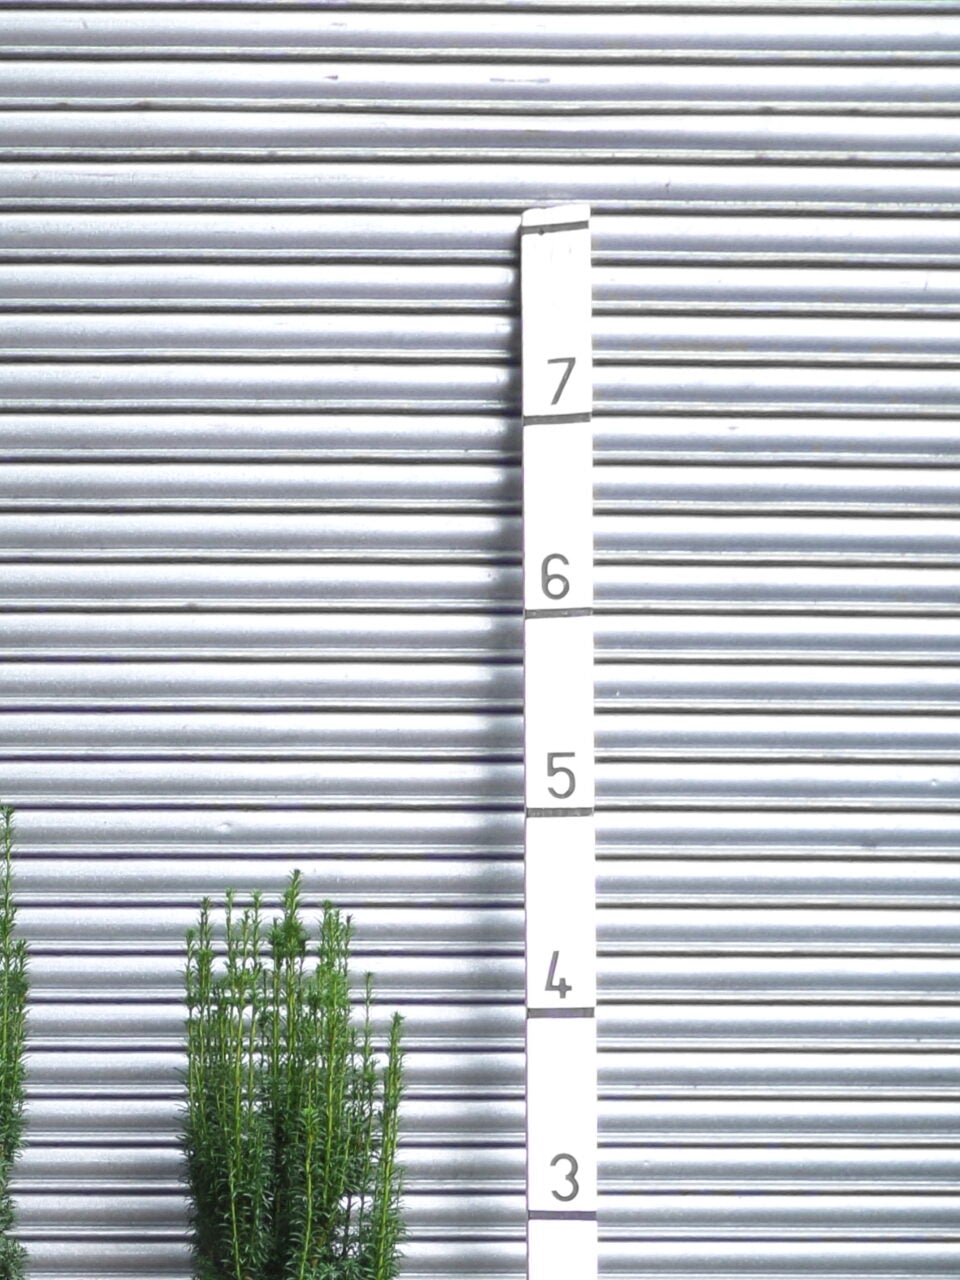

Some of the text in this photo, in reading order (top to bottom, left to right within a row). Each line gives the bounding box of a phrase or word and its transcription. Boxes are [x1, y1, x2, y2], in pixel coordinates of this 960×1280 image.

[547, 357, 576, 406] 7
[540, 553, 570, 600] 6
[547, 752, 577, 799] 5
[545, 951, 573, 999] 4
[550, 1153, 579, 1202] 3
